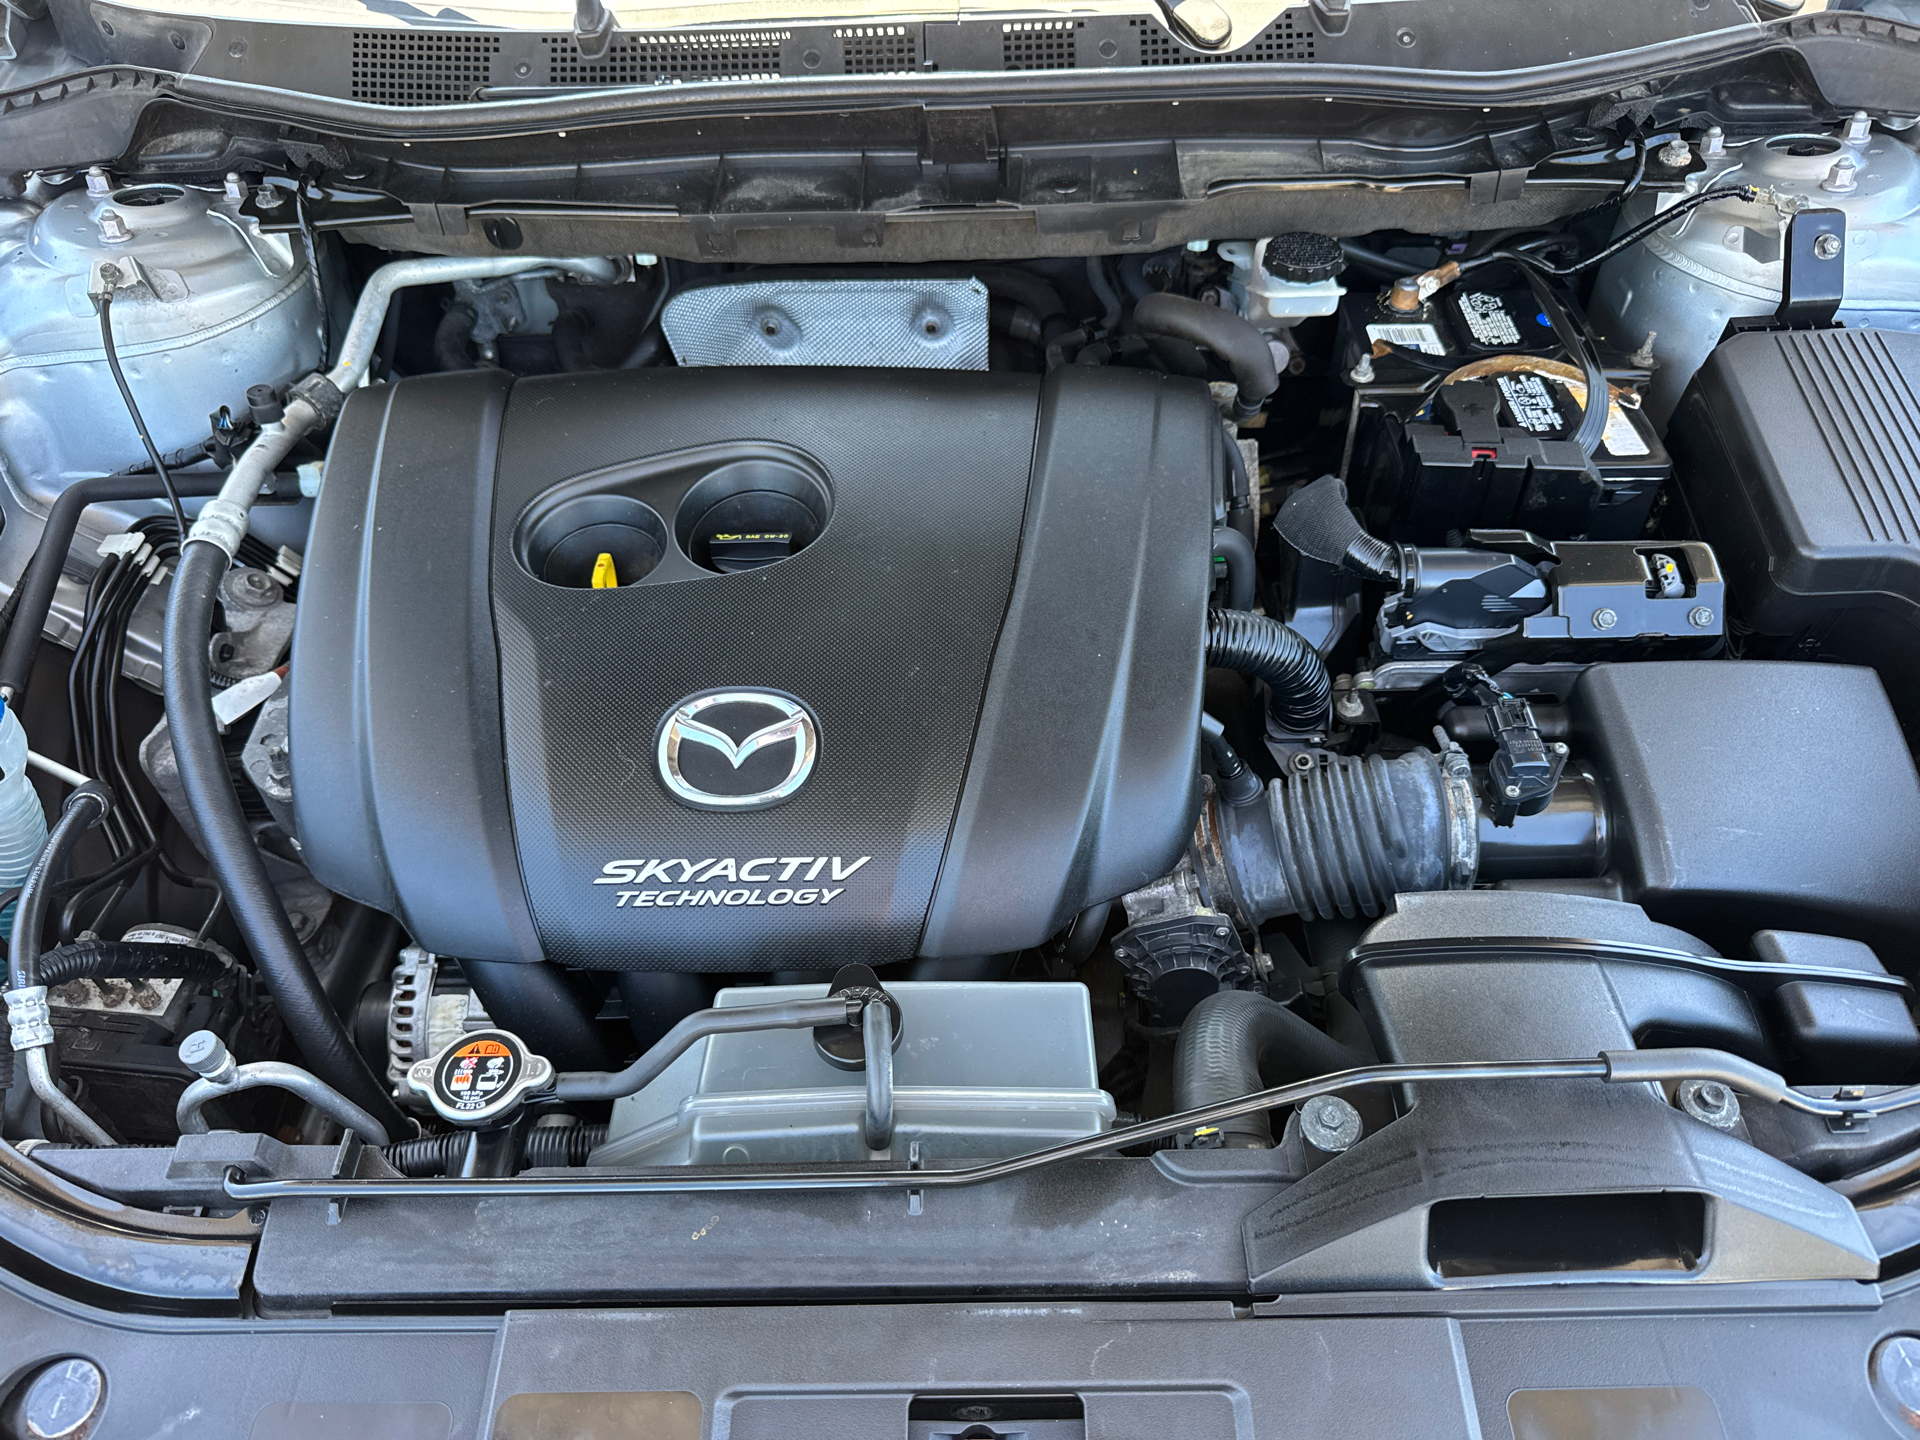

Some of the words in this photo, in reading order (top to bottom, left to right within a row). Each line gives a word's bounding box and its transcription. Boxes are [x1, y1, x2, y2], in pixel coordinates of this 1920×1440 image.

[592, 855, 872, 885] SKYACTIV
[615, 887, 846, 908] TECHNOLOGY
[455, 1101, 475, 1110] FL22
